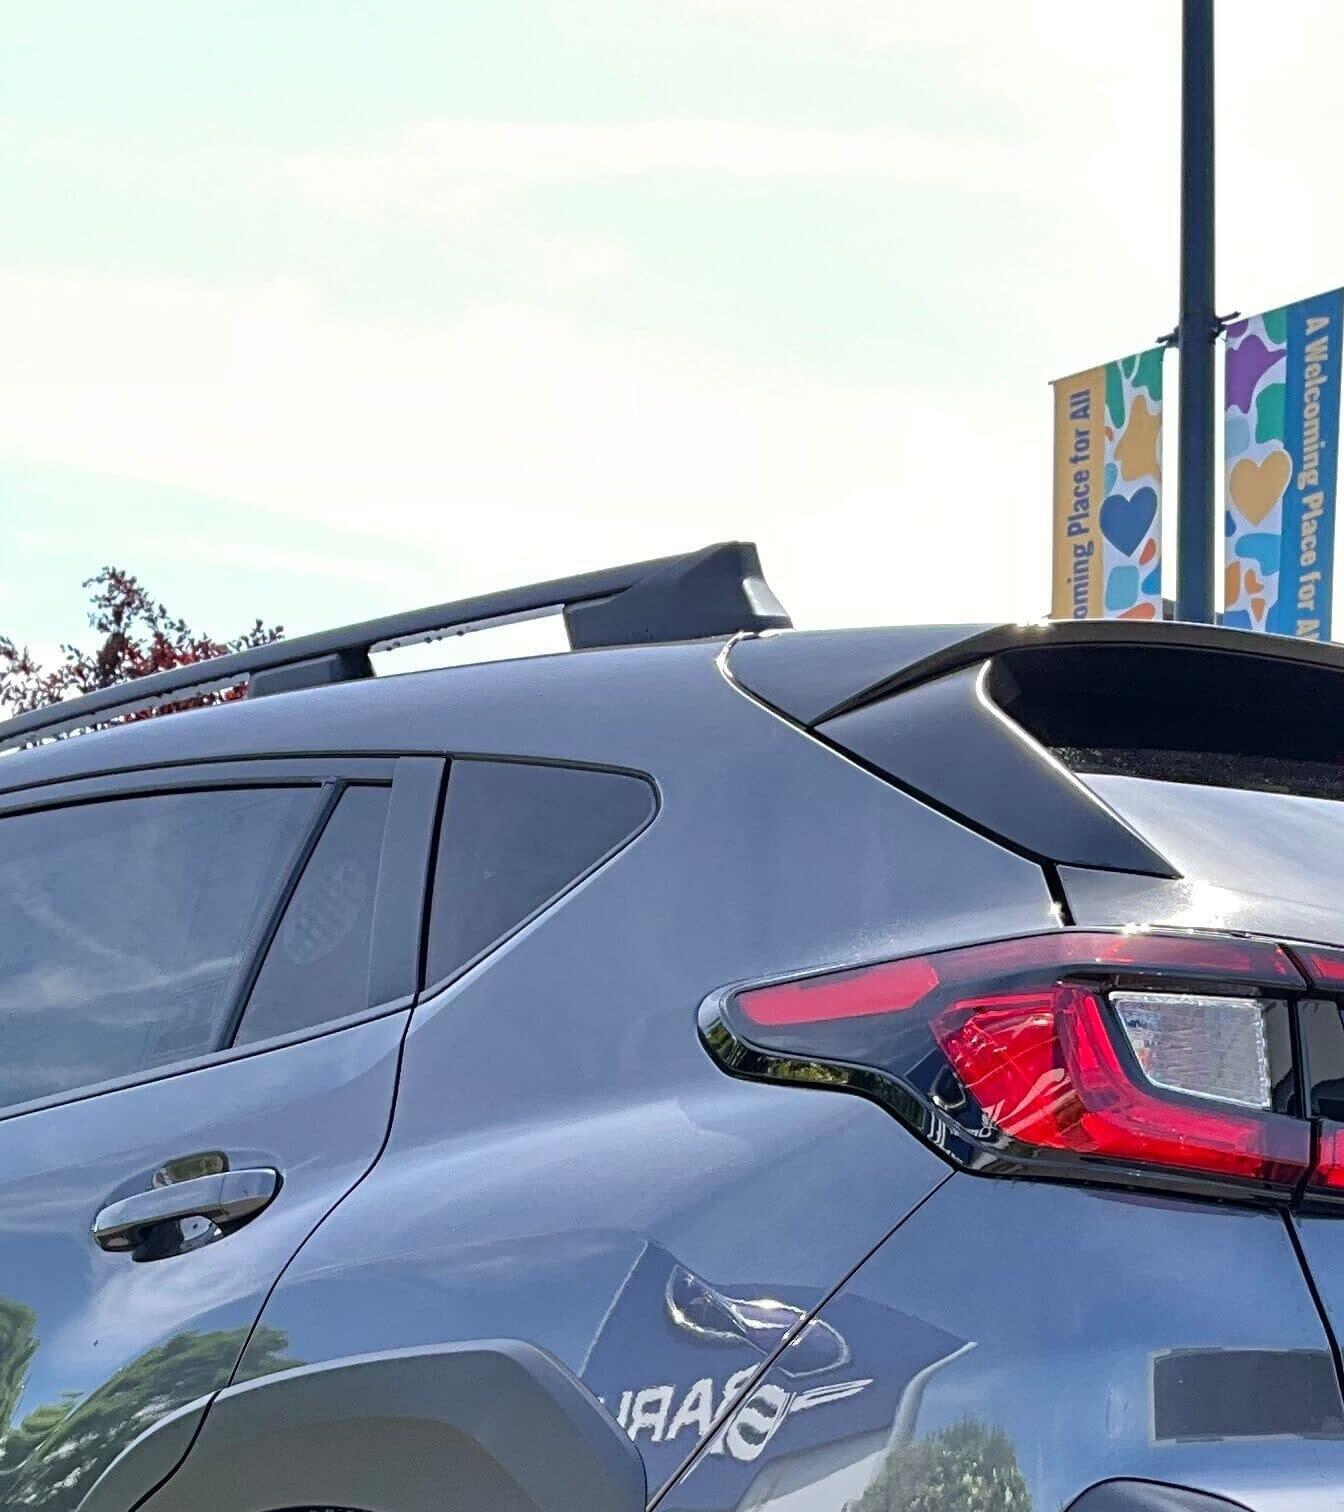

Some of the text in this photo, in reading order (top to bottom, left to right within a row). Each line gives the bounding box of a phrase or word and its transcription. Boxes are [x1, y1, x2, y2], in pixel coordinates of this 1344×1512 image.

[1305, 316, 1330, 336] A
[1297, 336, 1329, 491] Welcoming
[1066, 389, 1094, 619] oming Place for All
[1300, 491, 1324, 567] Place
[1297, 571, 1322, 611] for
